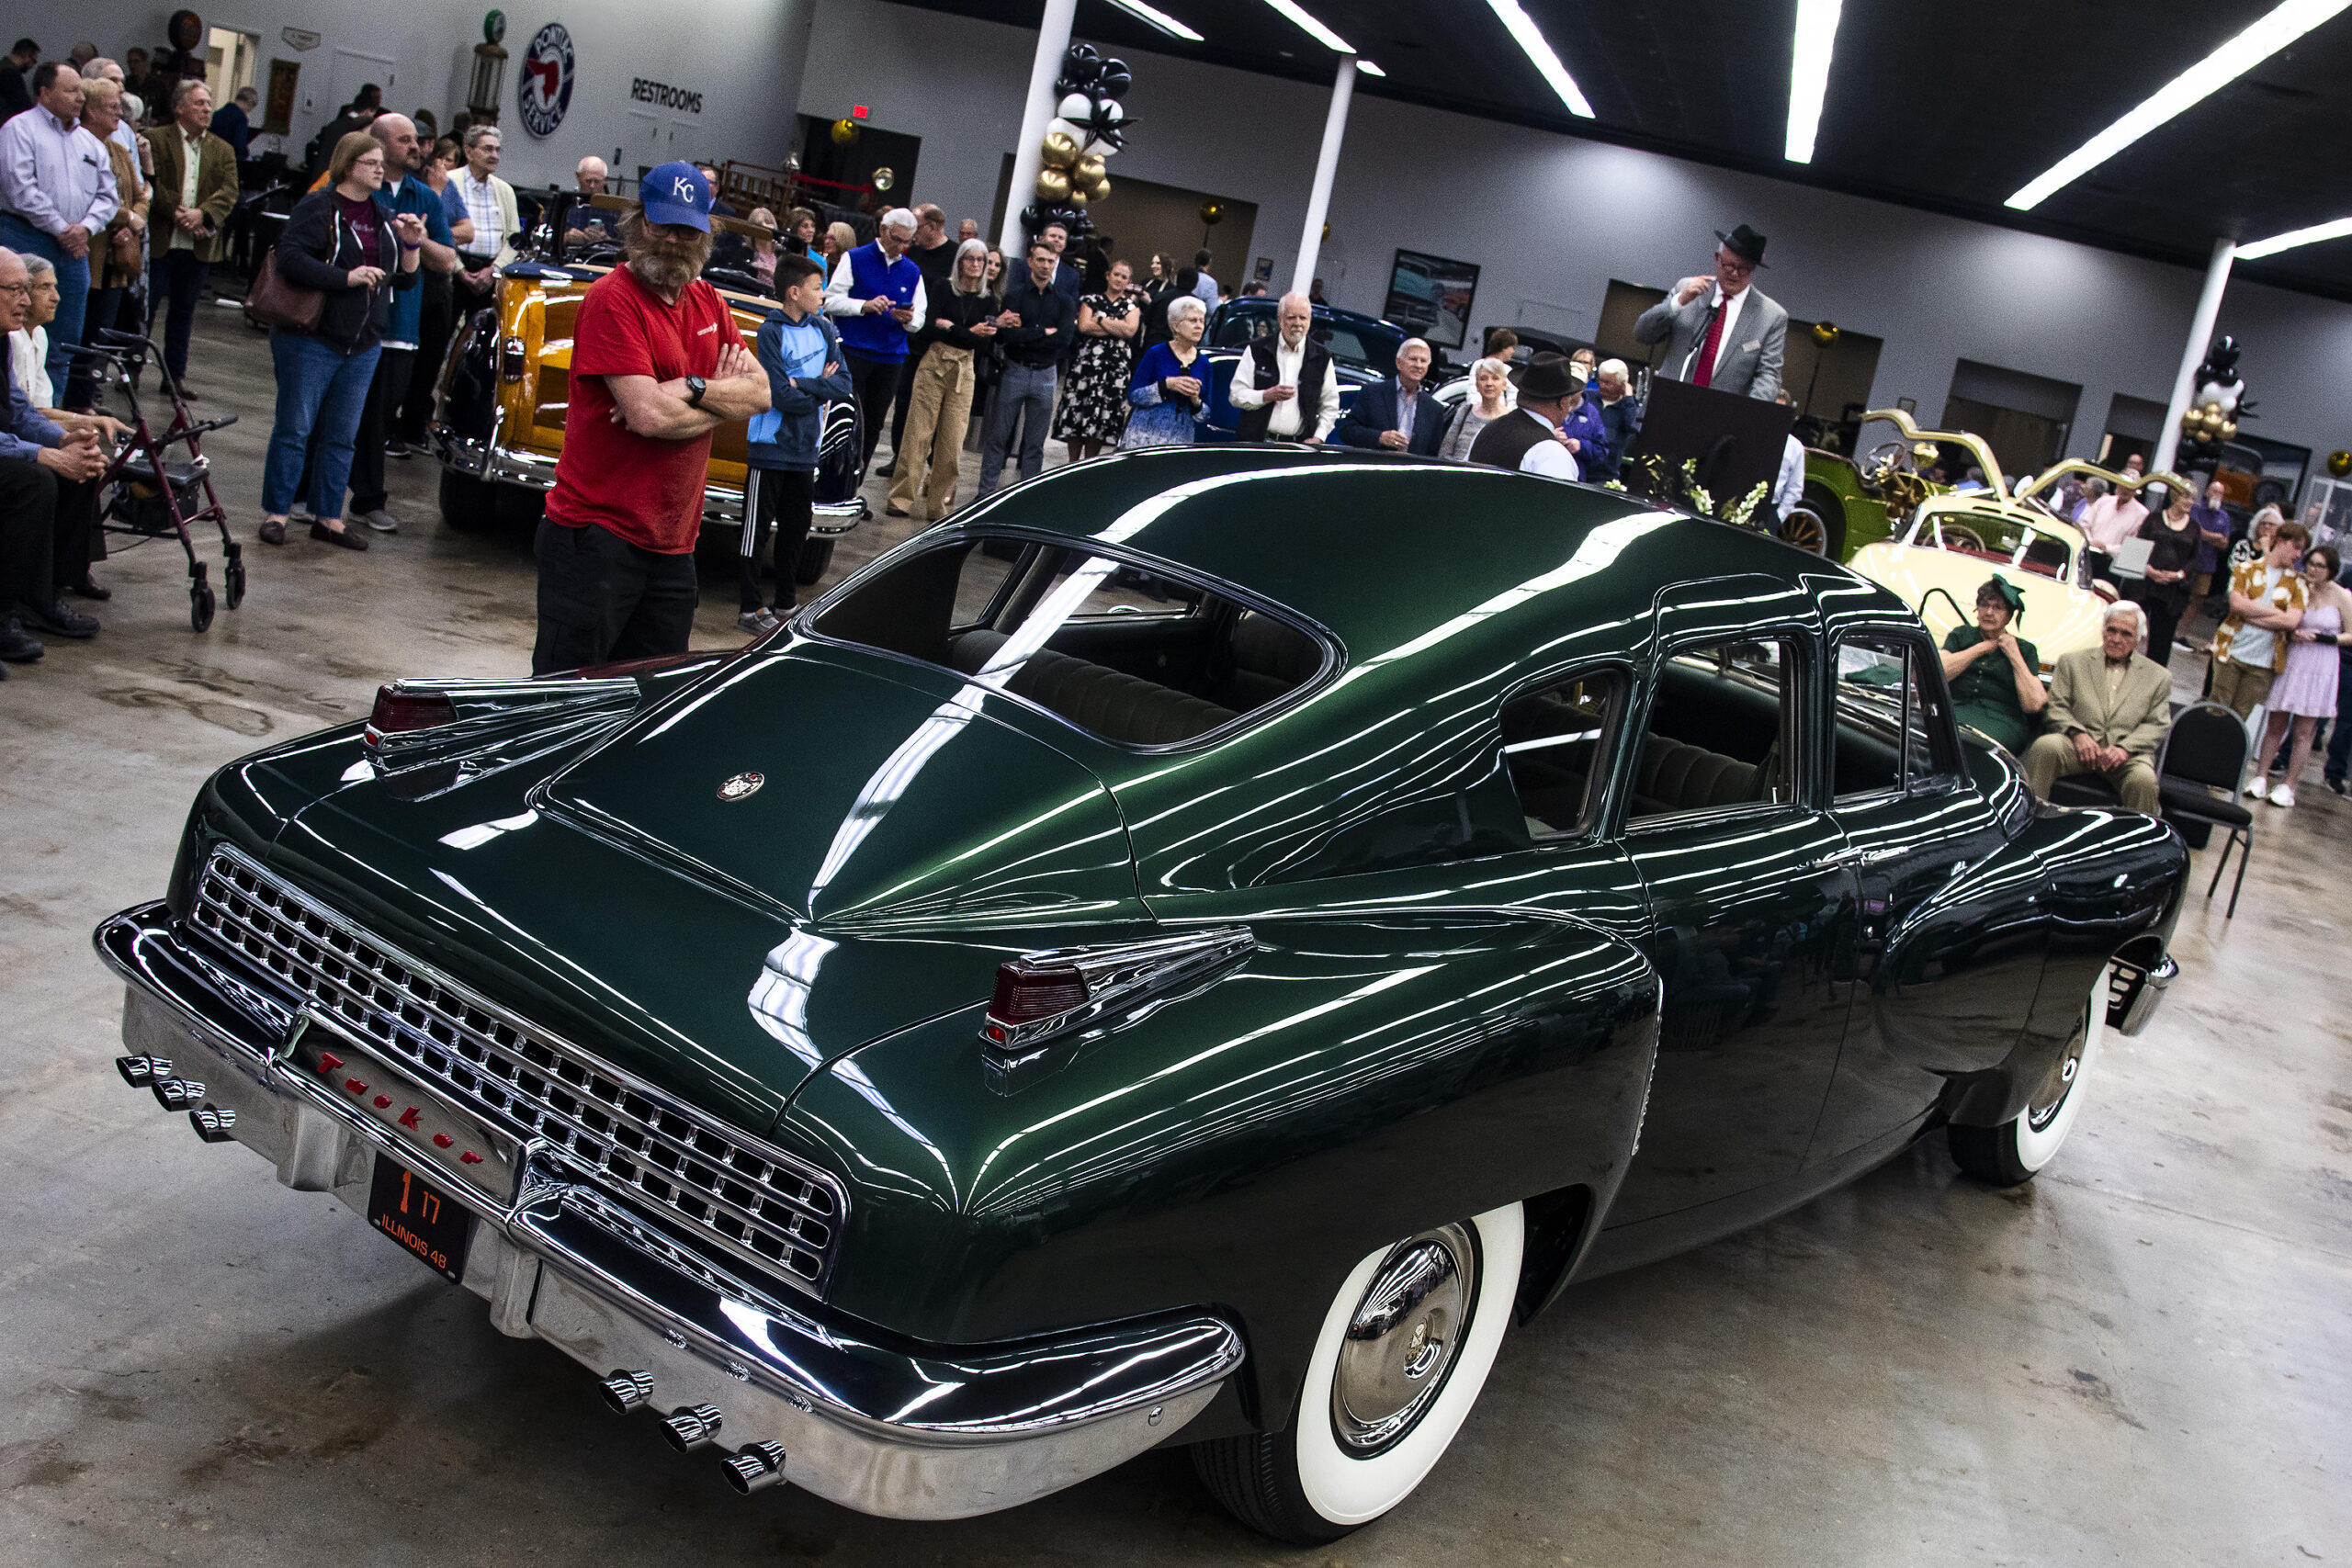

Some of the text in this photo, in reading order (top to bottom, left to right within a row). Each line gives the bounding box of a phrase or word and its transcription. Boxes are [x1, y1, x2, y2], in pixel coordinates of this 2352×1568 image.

[534, 26, 573, 63] PONTIAC
[524, 94, 563, 134] SERVICE
[630, 78, 703, 114] RESTROOMS
[673, 176, 695, 203] KC
[422, 1190, 441, 1224] 17
[381, 1213, 447, 1269] ILLINOIS 48
